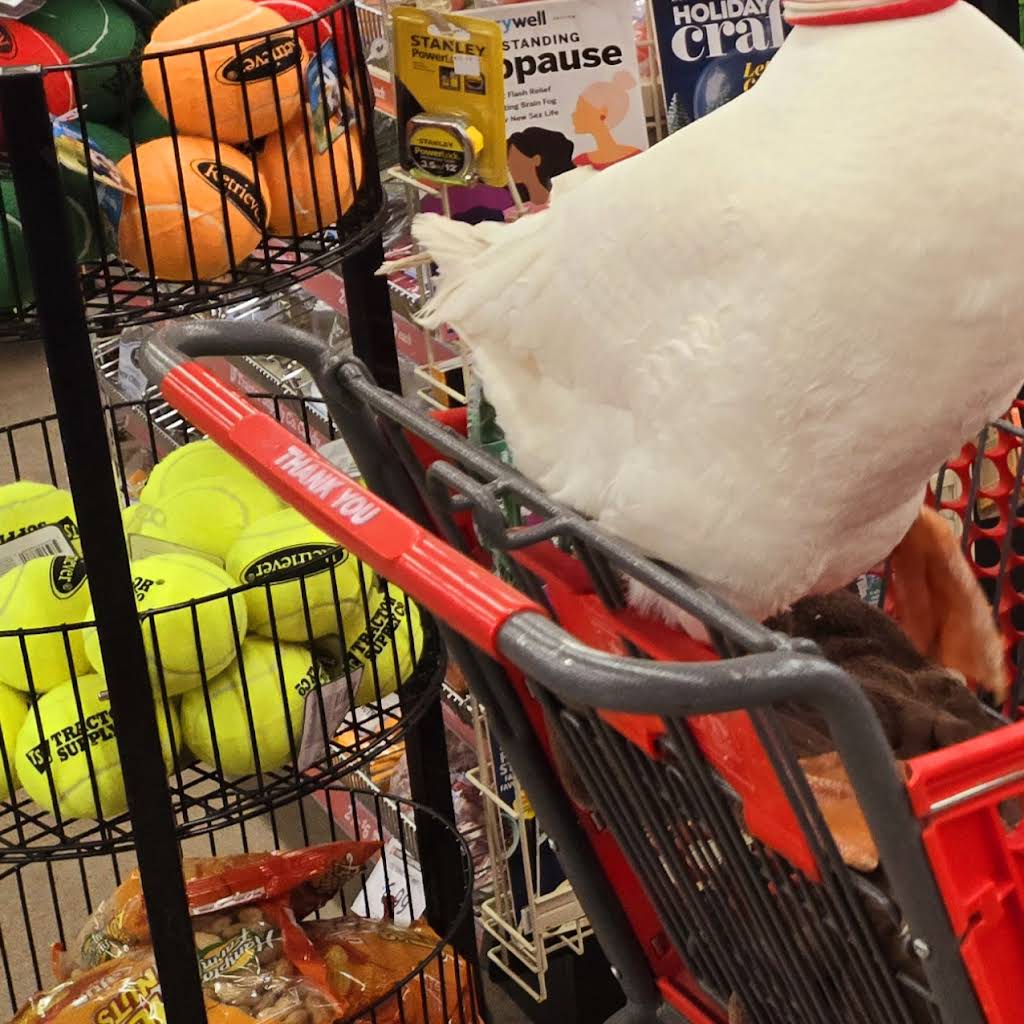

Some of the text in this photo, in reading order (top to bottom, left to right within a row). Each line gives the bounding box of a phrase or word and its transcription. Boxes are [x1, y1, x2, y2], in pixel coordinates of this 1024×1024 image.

[496, 10, 547, 32] ywell
[410, 34, 486, 57] STANLEY
[502, 32, 581, 51] STANDING
[507, 86, 552, 99] Flash Relief
[520, 99, 541, 110] Brain
[542, 97, 557, 108] Fog
[510, 112, 527, 122] New
[544, 110, 559, 119] Life
[274, 445, 382, 526] THANK YOU
